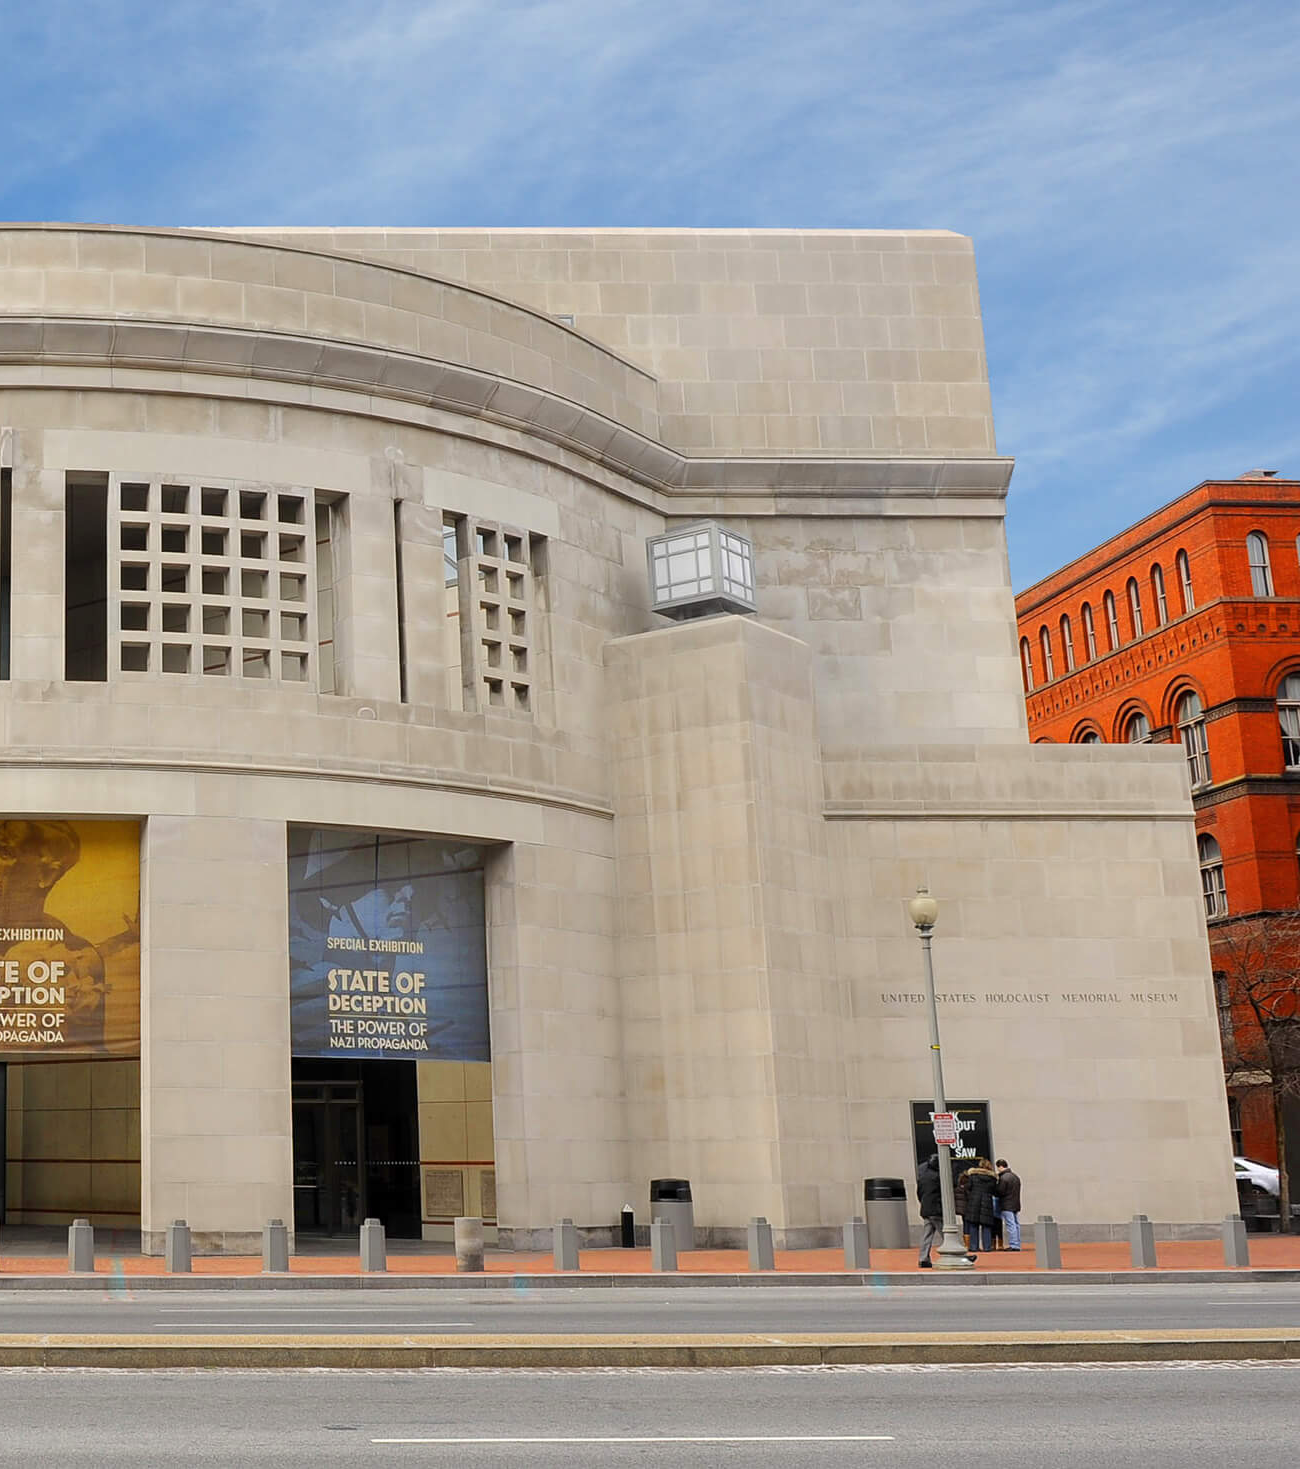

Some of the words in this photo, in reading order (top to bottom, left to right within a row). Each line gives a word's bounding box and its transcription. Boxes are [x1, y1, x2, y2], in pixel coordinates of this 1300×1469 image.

[327, 937, 367, 951] SPECIAL
[369, 939, 423, 954] EXHIBITION
[27, 961, 64, 983] OF
[328, 969, 390, 992] STATE
[396, 972, 425, 994] OF
[329, 994, 426, 1014] DECEPTION
[881, 993, 925, 1003] UNITED
[934, 993, 977, 1003] STATES
[985, 993, 1050, 1003] HOLOCAUST
[1060, 993, 1121, 1003] MEMORIAL
[1130, 993, 1179, 1003] MUSEUM
[41, 1013, 65, 1028] OF
[329, 1020, 354, 1034] THE
[358, 1021, 405, 1036] POWER
[409, 1022, 427, 1036] OF
[330, 1036, 355, 1049] NAZI
[358, 1038, 428, 1051] PROPAGANDA
[955, 1147, 976, 1158] SAW
